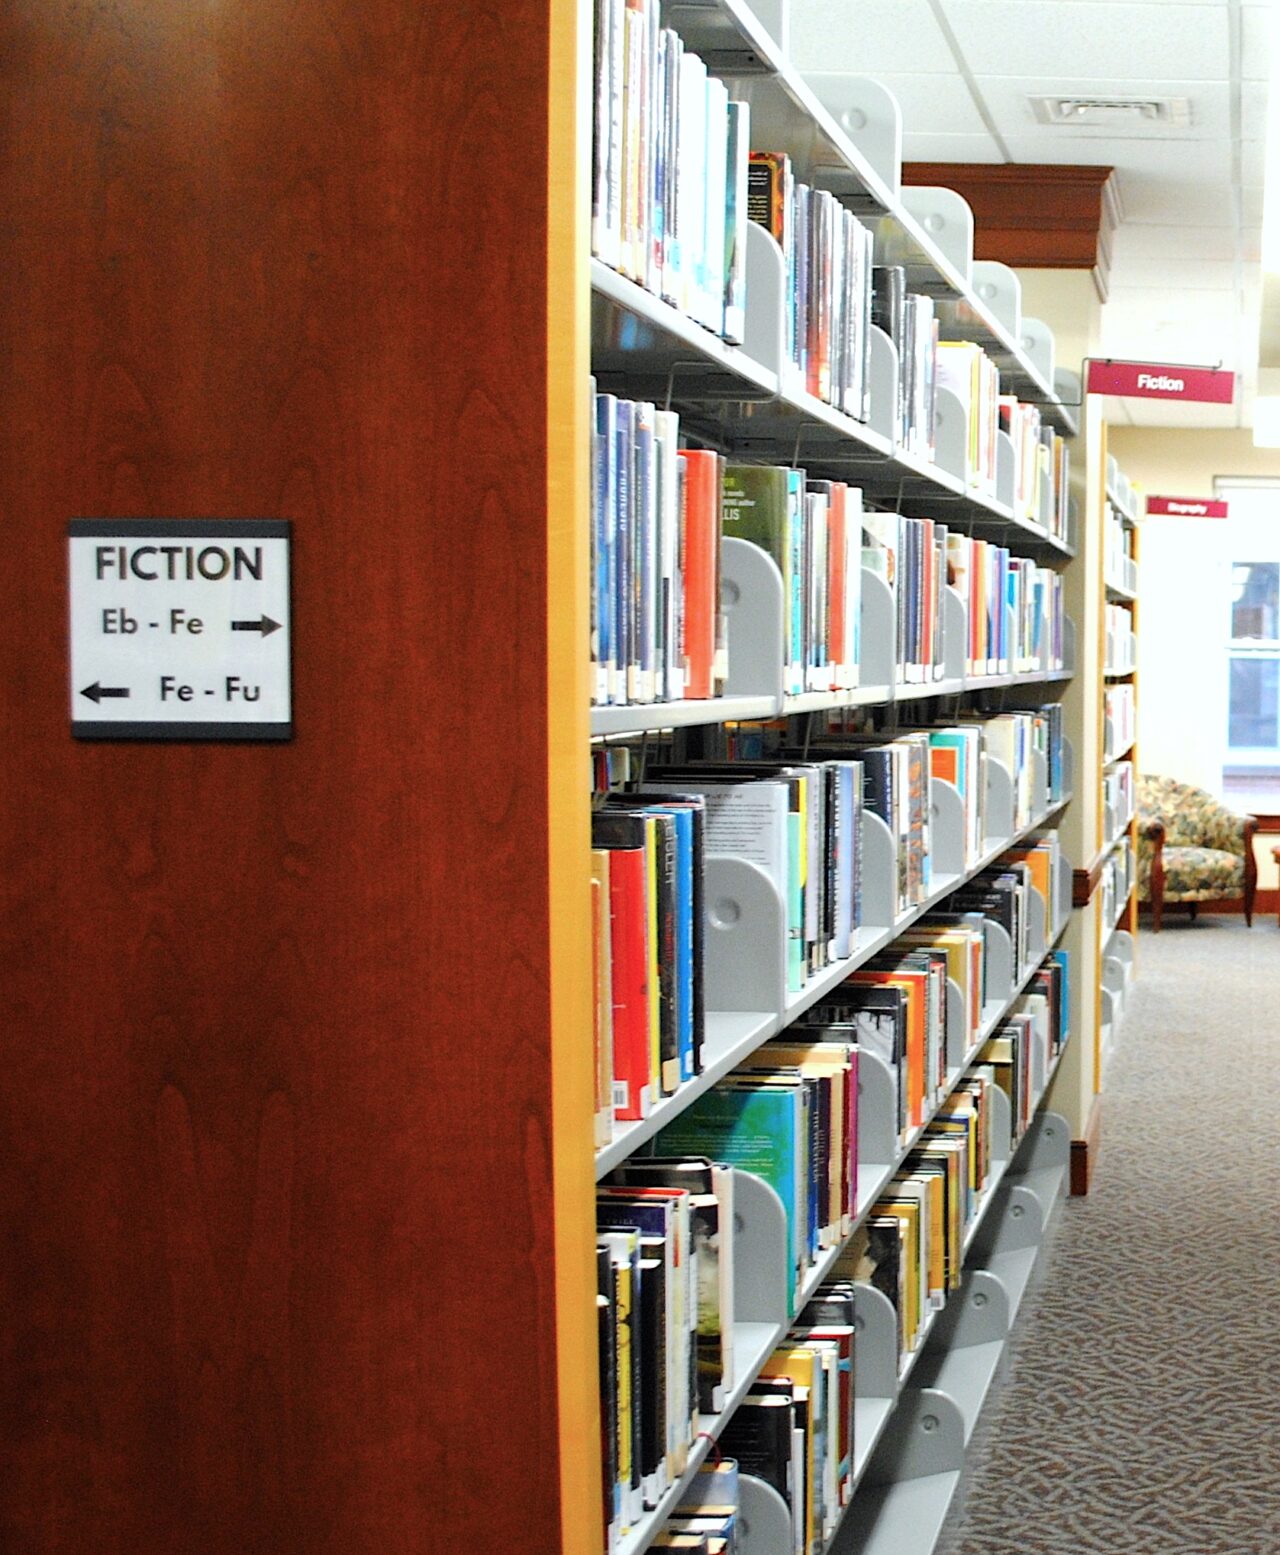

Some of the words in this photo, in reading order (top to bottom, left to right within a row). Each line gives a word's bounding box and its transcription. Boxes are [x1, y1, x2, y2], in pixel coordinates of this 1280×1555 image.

[1137, 374, 1184, 391] Fiction
[95, 546, 264, 581] FICTION
[102, 608, 138, 634] Eb
[169, 608, 204, 634] Fe
[160, 676, 194, 701] Fe
[225, 676, 260, 702] Fu
